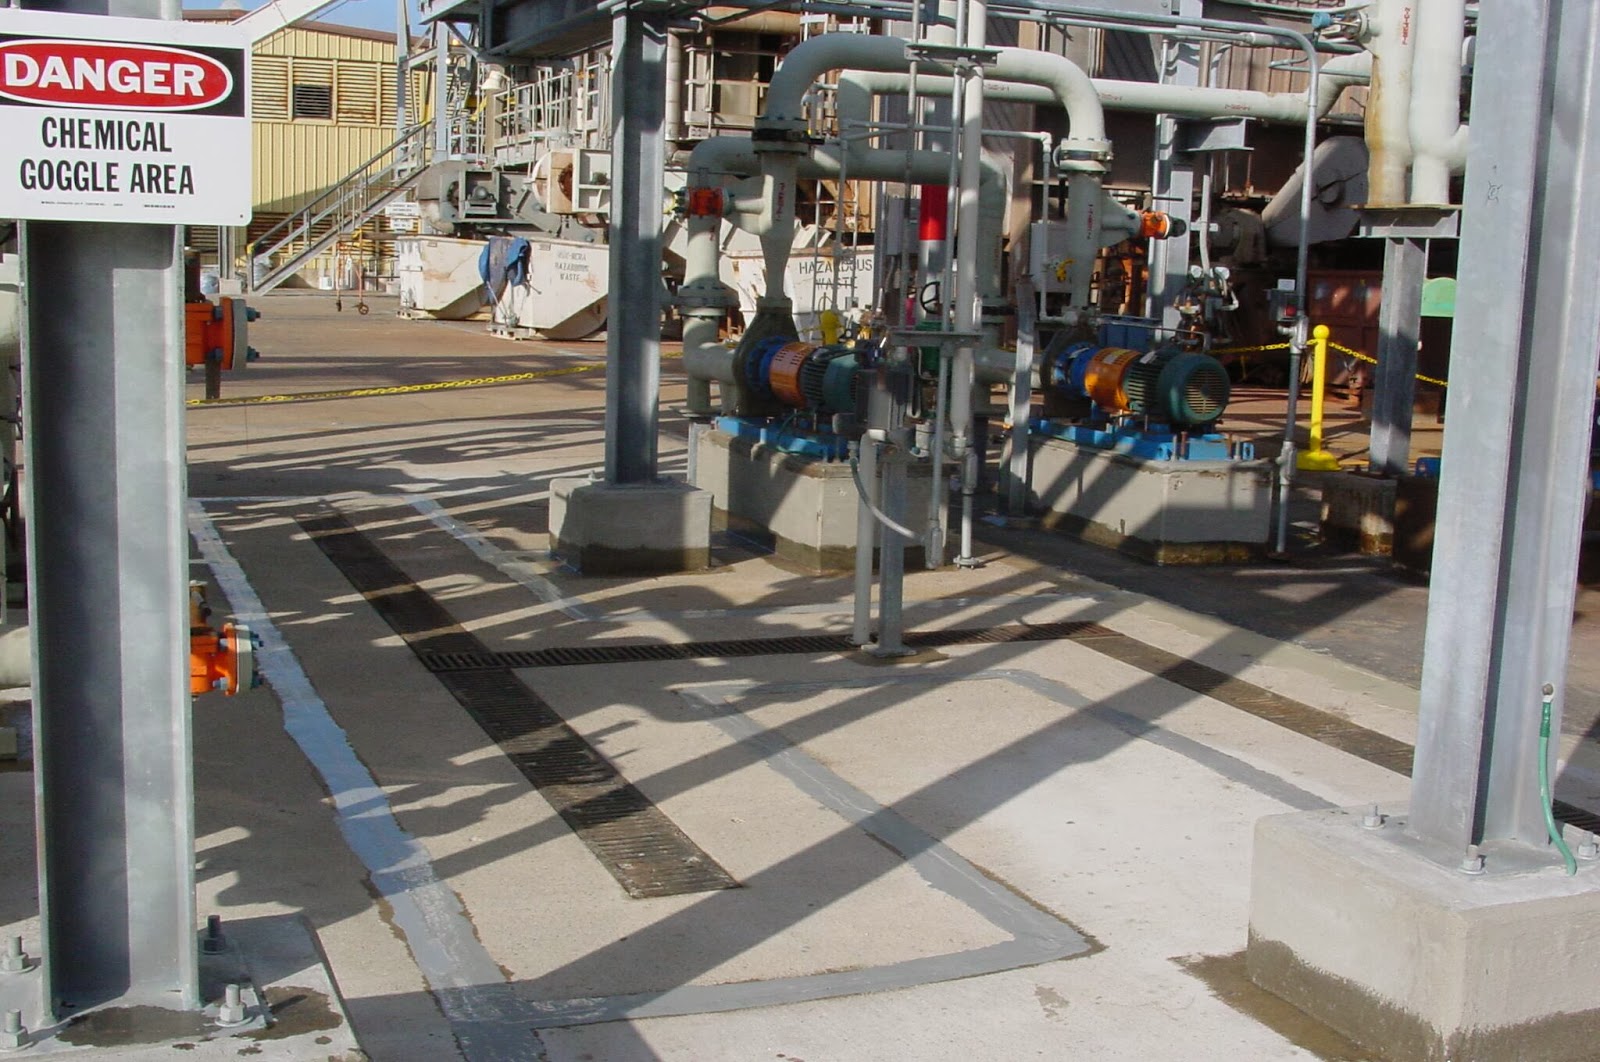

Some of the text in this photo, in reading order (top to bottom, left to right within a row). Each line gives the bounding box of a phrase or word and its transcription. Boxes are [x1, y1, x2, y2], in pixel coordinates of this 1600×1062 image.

[4, 53, 205, 96] DANGER
[42, 116, 172, 152] CHEMICAL
[20, 158, 195, 195] GOGGLE AREA
[799, 259, 873, 275] HAZADOUS
